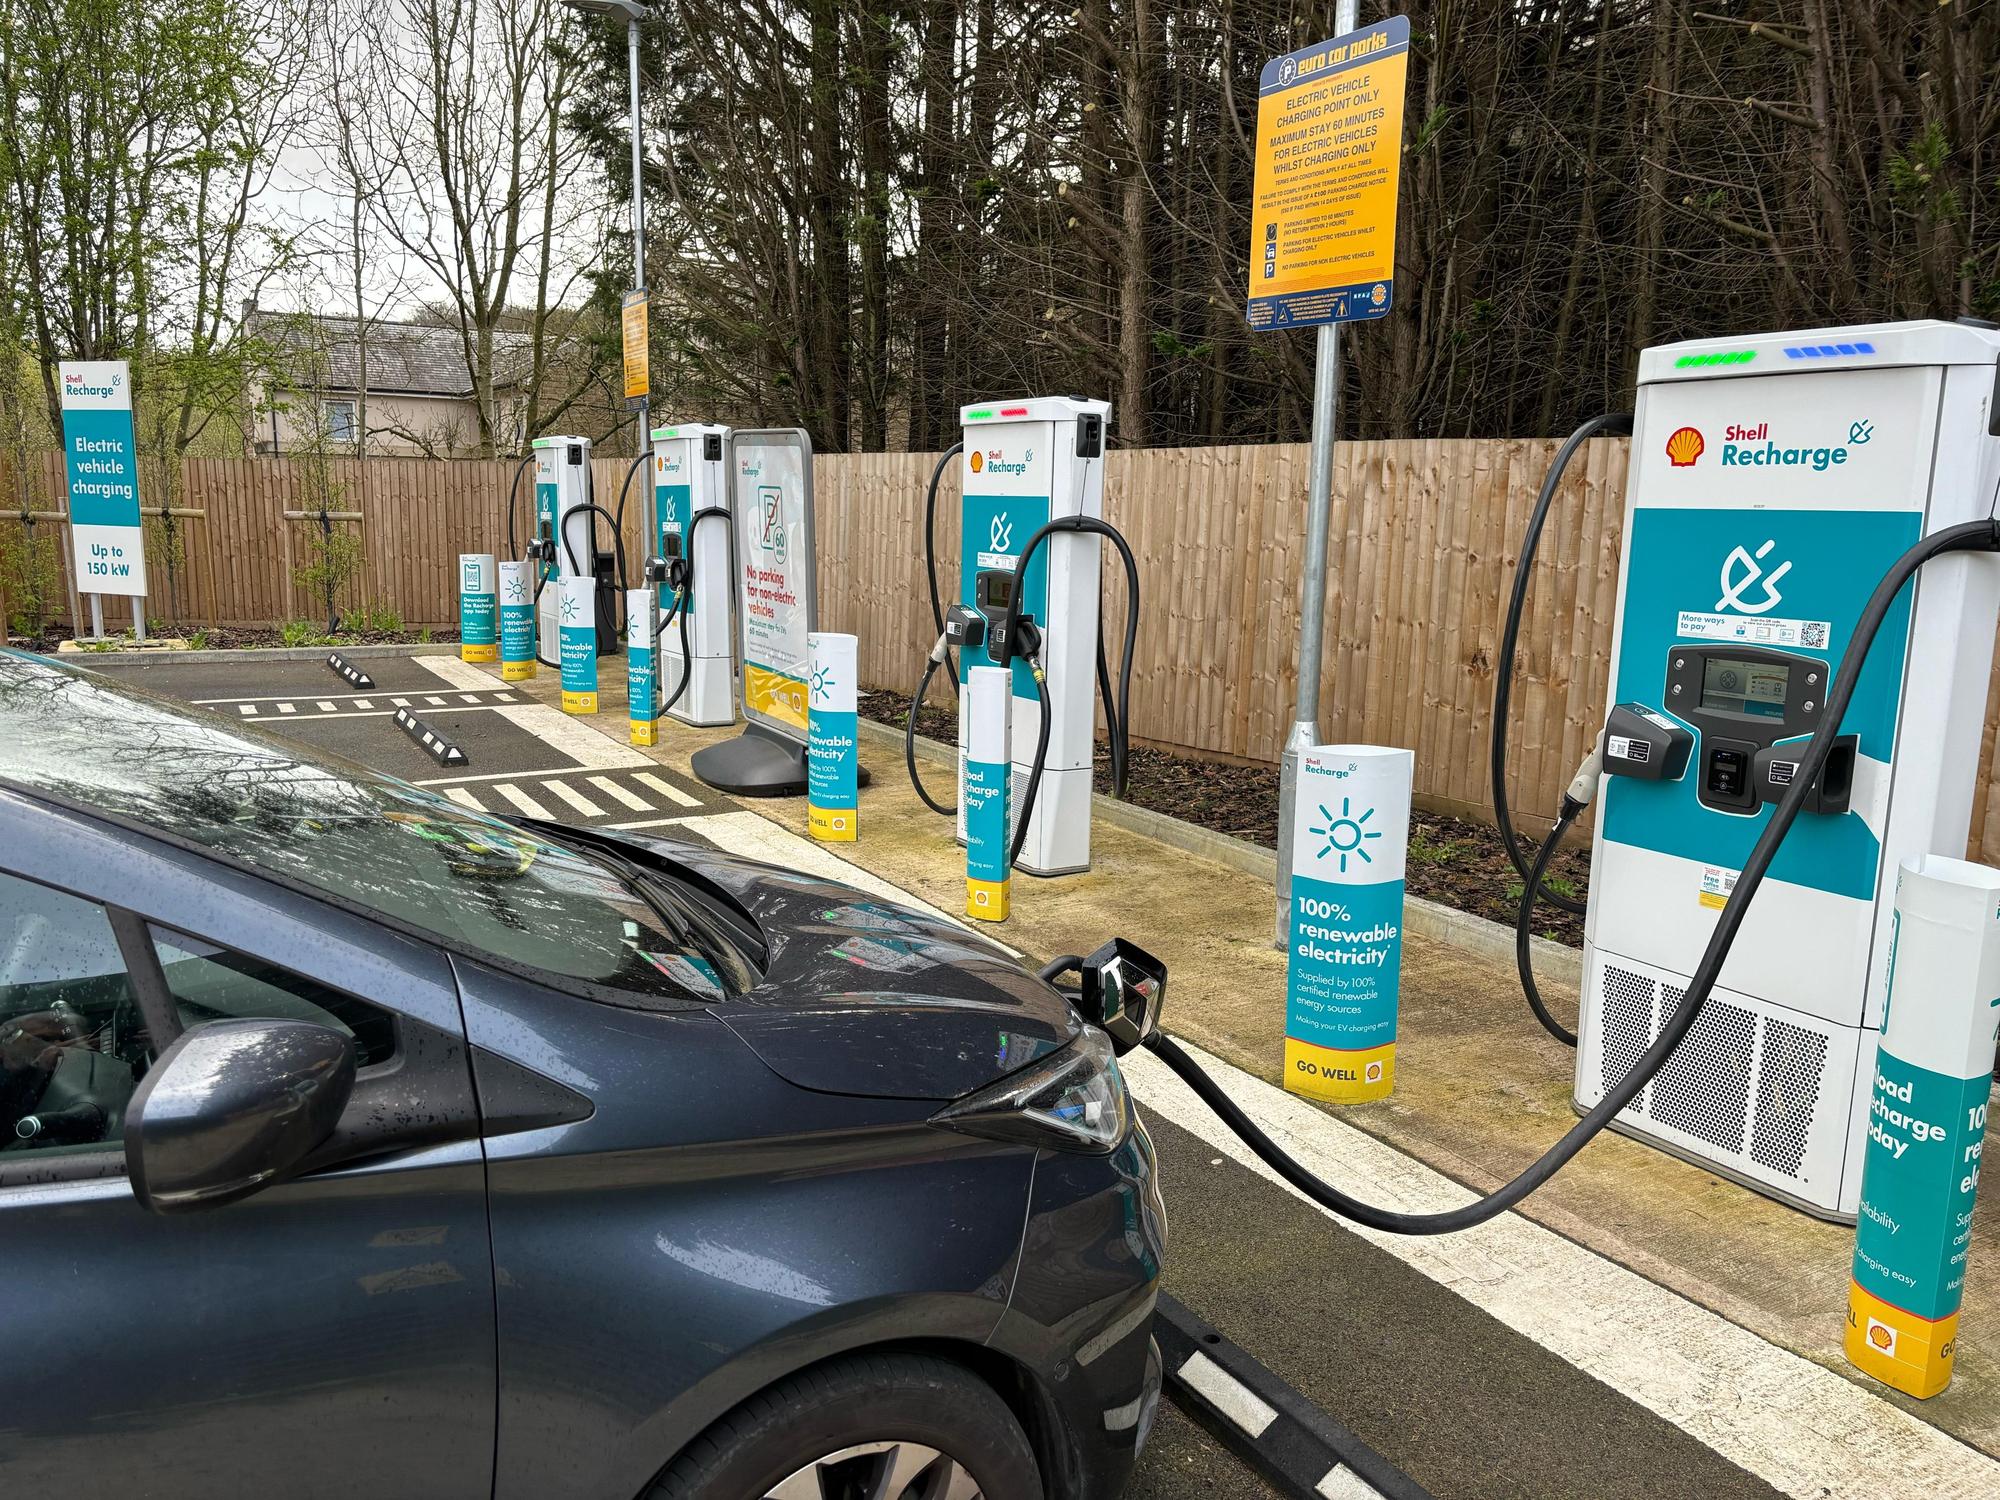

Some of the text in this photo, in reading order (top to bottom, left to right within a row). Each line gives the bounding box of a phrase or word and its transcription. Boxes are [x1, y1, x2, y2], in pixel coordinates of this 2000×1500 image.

[1298, 32, 1388, 75] euro car parks
[1286, 76, 1370, 110] ELECTRIC VEHICLE
[1276, 89, 1380, 128] CHARGING POINT ONLY
[1270, 108, 1384, 148] MAXIMUM STAY 60 MINUTES
[1274, 124, 1378, 160] FOR ELECTRIC VEHICLES
[1274, 140, 1376, 174] WHILST CHARGING ONLY
[1283, 239, 1302, 247] PARKING
[1302, 237, 1312, 245] FOR
[1312, 234, 1334, 243] ELECTRIC
[1334, 230, 1357, 239] VEHICLES
[1283, 247, 1304, 255] CHARGING
[1289, 261, 1308, 270] PARKING
[1309, 259, 1318, 267] FOR
[1329, 254, 1351, 263] ELECTRIC
[1352, 251, 1375, 260] VEHICLES
[66, 375, 82, 384] Shell
[66, 384, 114, 398] Recharge
[1725, 423, 1768, 442] Shell
[76, 438, 123, 453] Electric
[988, 450, 1002, 459] Shell
[1722, 442, 1848, 471] Recharge
[76, 459, 124, 474] vehicle
[988, 460, 1026, 476] Recharge
[72, 479, 132, 499] charging
[776, 533, 784, 547] 60
[91, 544, 123, 560] Up to
[87, 562, 130, 576] 150 kW
[746, 564, 784, 589] No parking
[748, 582, 796, 606] for non-electric
[748, 600, 774, 618] vehicles
[1681, 614, 1725, 625] More ways
[1690, 623, 1706, 634] pay
[1305, 764, 1349, 779] Recharge
[1704, 874, 1719, 883] free
[1299, 896, 1351, 921] 100%
[1299, 922, 1397, 943] renewable
[1298, 968, 1376, 989] Supplied by 100%
[1297, 984, 1378, 1000] certified renewable
[1296, 997, 1362, 1014] energy sources
[1296, 1014, 1319, 1028] Making
[1349, 1023, 1376, 1032] charging
[1297, 1060, 1357, 1080] GO WELL
[1858, 1248, 1917, 1288] charging easy
